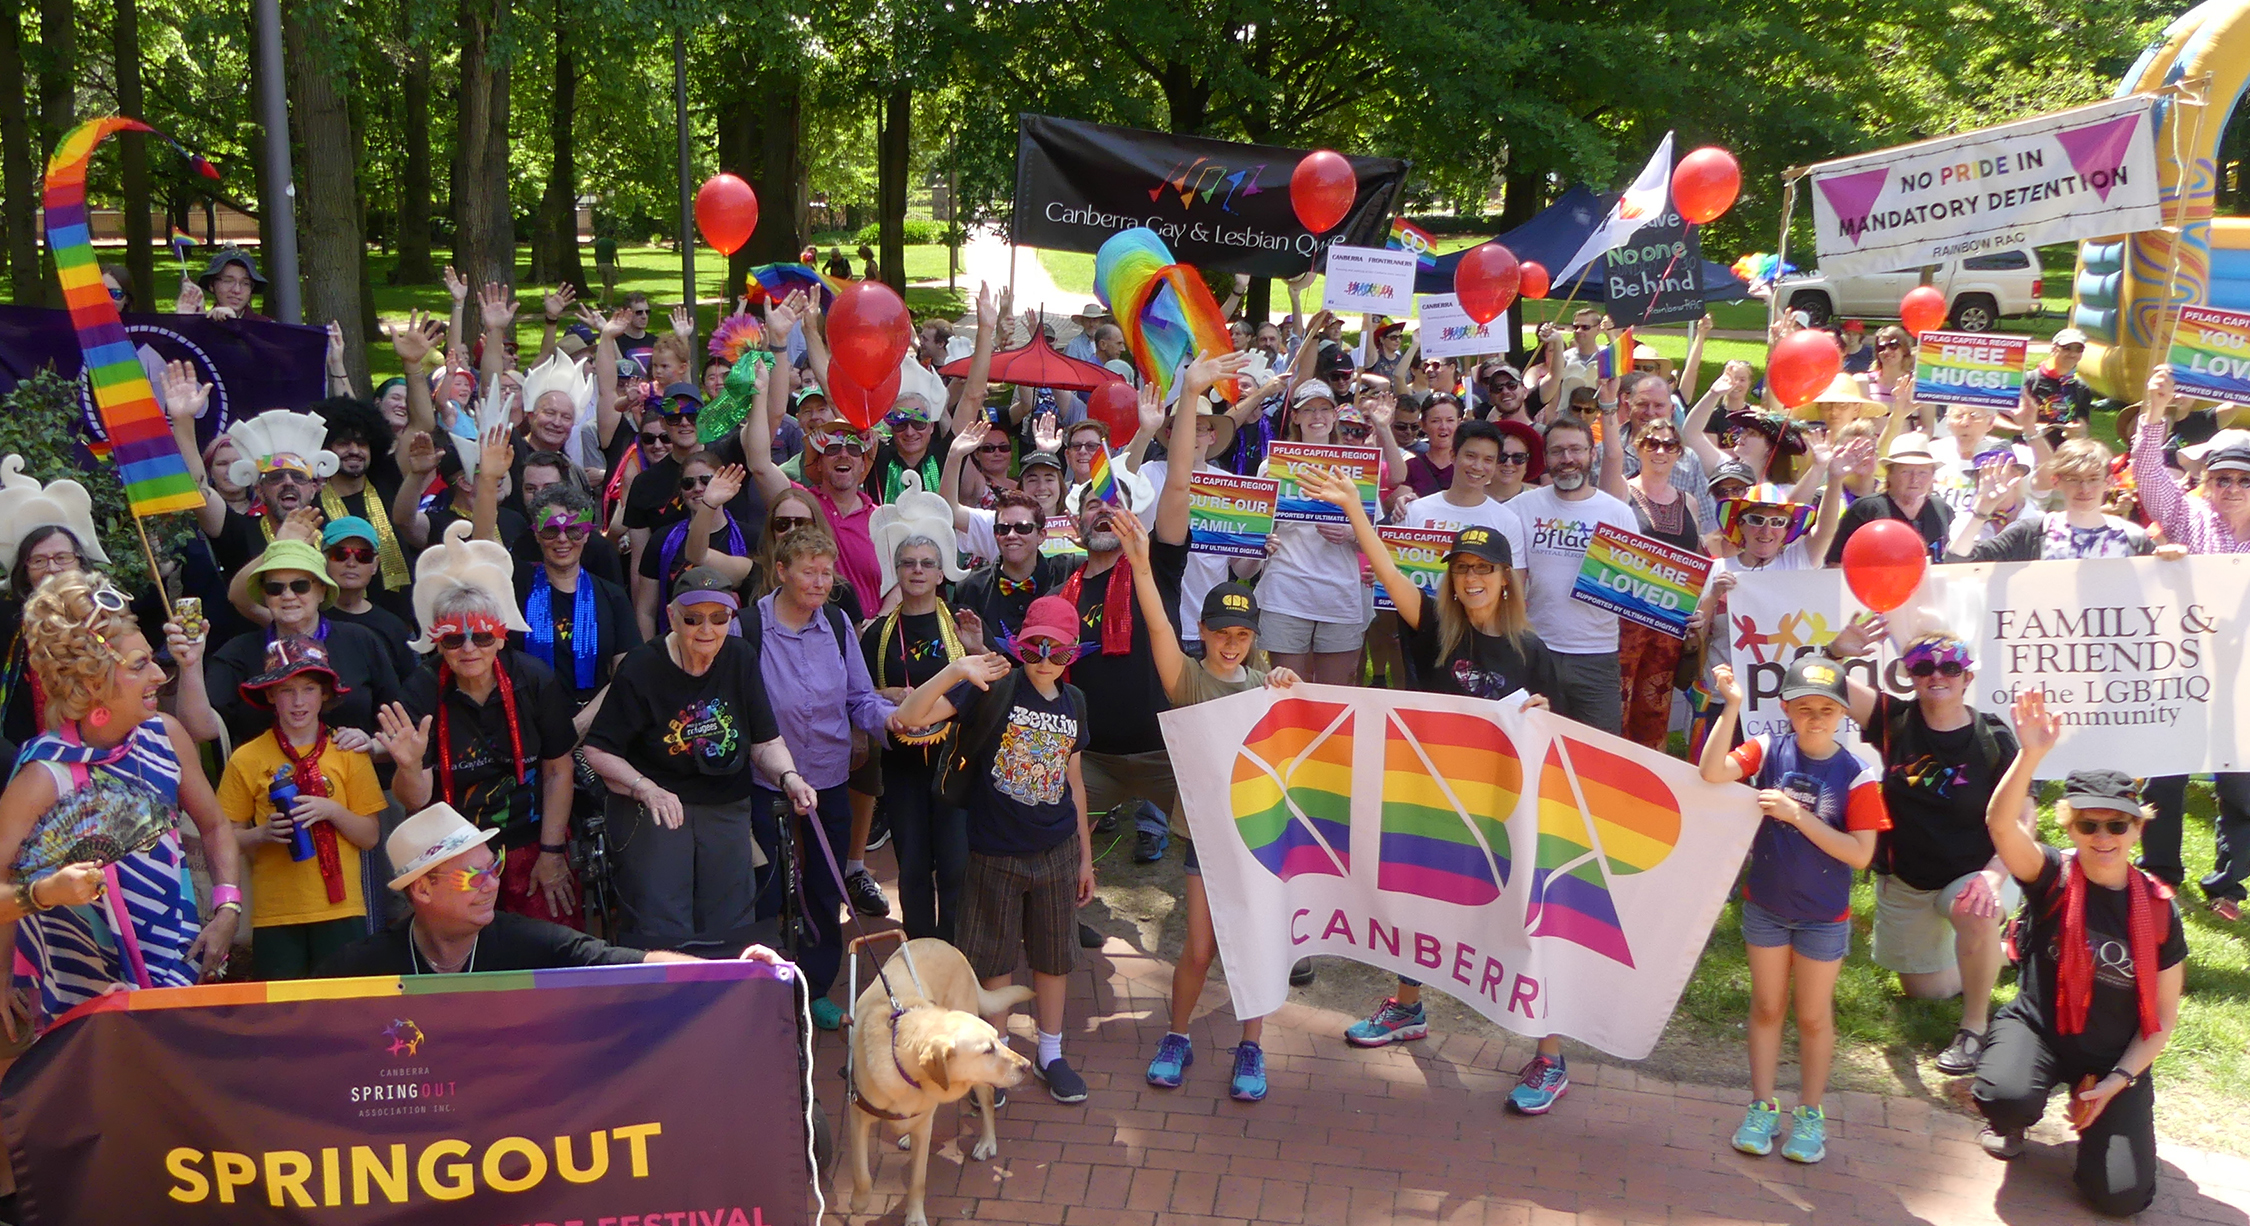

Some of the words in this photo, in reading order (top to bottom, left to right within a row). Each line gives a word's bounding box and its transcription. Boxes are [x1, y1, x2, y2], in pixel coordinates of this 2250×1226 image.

[1901, 172, 1932, 194] NO
[1940, 156, 2009, 186] PRIDE
[2017, 149, 2042, 171] IN
[1839, 195, 1980, 238] MANDATORY
[1988, 166, 2128, 212] DETENTION
[1046, 202, 1138, 229] Canberra
[1146, 216, 1188, 247] Gay
[1190, 223, 1209, 243] &
[1215, 225, 1288, 251] Lesbian
[1295, 234, 1346, 257] Qwe
[1933, 237, 1991, 258] RAINBOW
[1996, 231, 2025, 246] RAC
[1332, 254, 1363, 263] CANBERRA
[1368, 257, 1413, 267] FRONTRUNNERS
[1610, 270, 1694, 299] Behind
[1422, 302, 1453, 310] CANBERRA
[2185, 311, 2220, 324] PFLAG
[1923, 335, 1951, 344] PFLAG
[1953, 337, 1987, 346] CAPITAL
[1989, 339, 2023, 348] REGION
[2198, 328, 2245, 349] YOU
[1941, 345, 2007, 366] FREE
[1930, 367, 2010, 389] HUGS!
[1916, 393, 1952, 401] SUPPORTED
[1991, 398, 2014, 406] DIGITAL
[2212, 388, 2223, 397] BY
[1273, 446, 1302, 456] PFLAG
[1303, 448, 1340, 459] CAPITAL
[1342, 450, 1376, 461] REGION
[1202, 477, 1239, 489] CAPITAL
[1241, 480, 1274, 491] REGION
[1189, 493, 1230, 511] OU'RE
[1235, 498, 1268, 514] OUR
[1045, 520, 1071, 528] APITA
[1190, 517, 1247, 535] FAMILY
[1315, 514, 1345, 522] ULTIMATE
[1382, 531, 1412, 540] PFLAG
[1414, 533, 1453, 543] CAPITAL
[1200, 543, 1208, 551] BY
[1209, 544, 1239, 553] ULTIMATE
[1239, 547, 1263, 556] DIGITAL
[1396, 547, 1435, 563] YOU
[1564, 550, 1585, 559] REGI
[1599, 527, 1629, 543] PFLAG
[1630, 538, 1668, 558] CAPITAL
[1669, 553, 1707, 571] REGION
[1608, 546, 1649, 571] YOU
[1650, 563, 1689, 587] ARE
[1598, 568, 1680, 611] LOVED
[1576, 591, 1614, 611] SUPPORTED
[1613, 605, 1623, 614] BY
[1623, 609, 1655, 625] ULTIMATE
[1654, 620, 1681, 635] DIGITAL
[1992, 606, 2165, 640] FAMILY
[2180, 604, 2218, 634] &
[2007, 638, 2200, 674] FRIENDS
[1992, 681, 2021, 705] of
[2031, 681, 2074, 704] he
[2085, 675, 2211, 705] LGBTIQ
[2045, 702, 2181, 727] mmunity
[1291, 908, 1549, 1020] CANBERR
[380, 1067, 430, 1077] CANBERRA
[351, 1081, 456, 1102] SPRINGOUT
[359, 1106, 426, 1117] ASSOCIATION
[434, 1104, 456, 1113] INC.
[165, 1122, 663, 1208] SPRINGOUT
